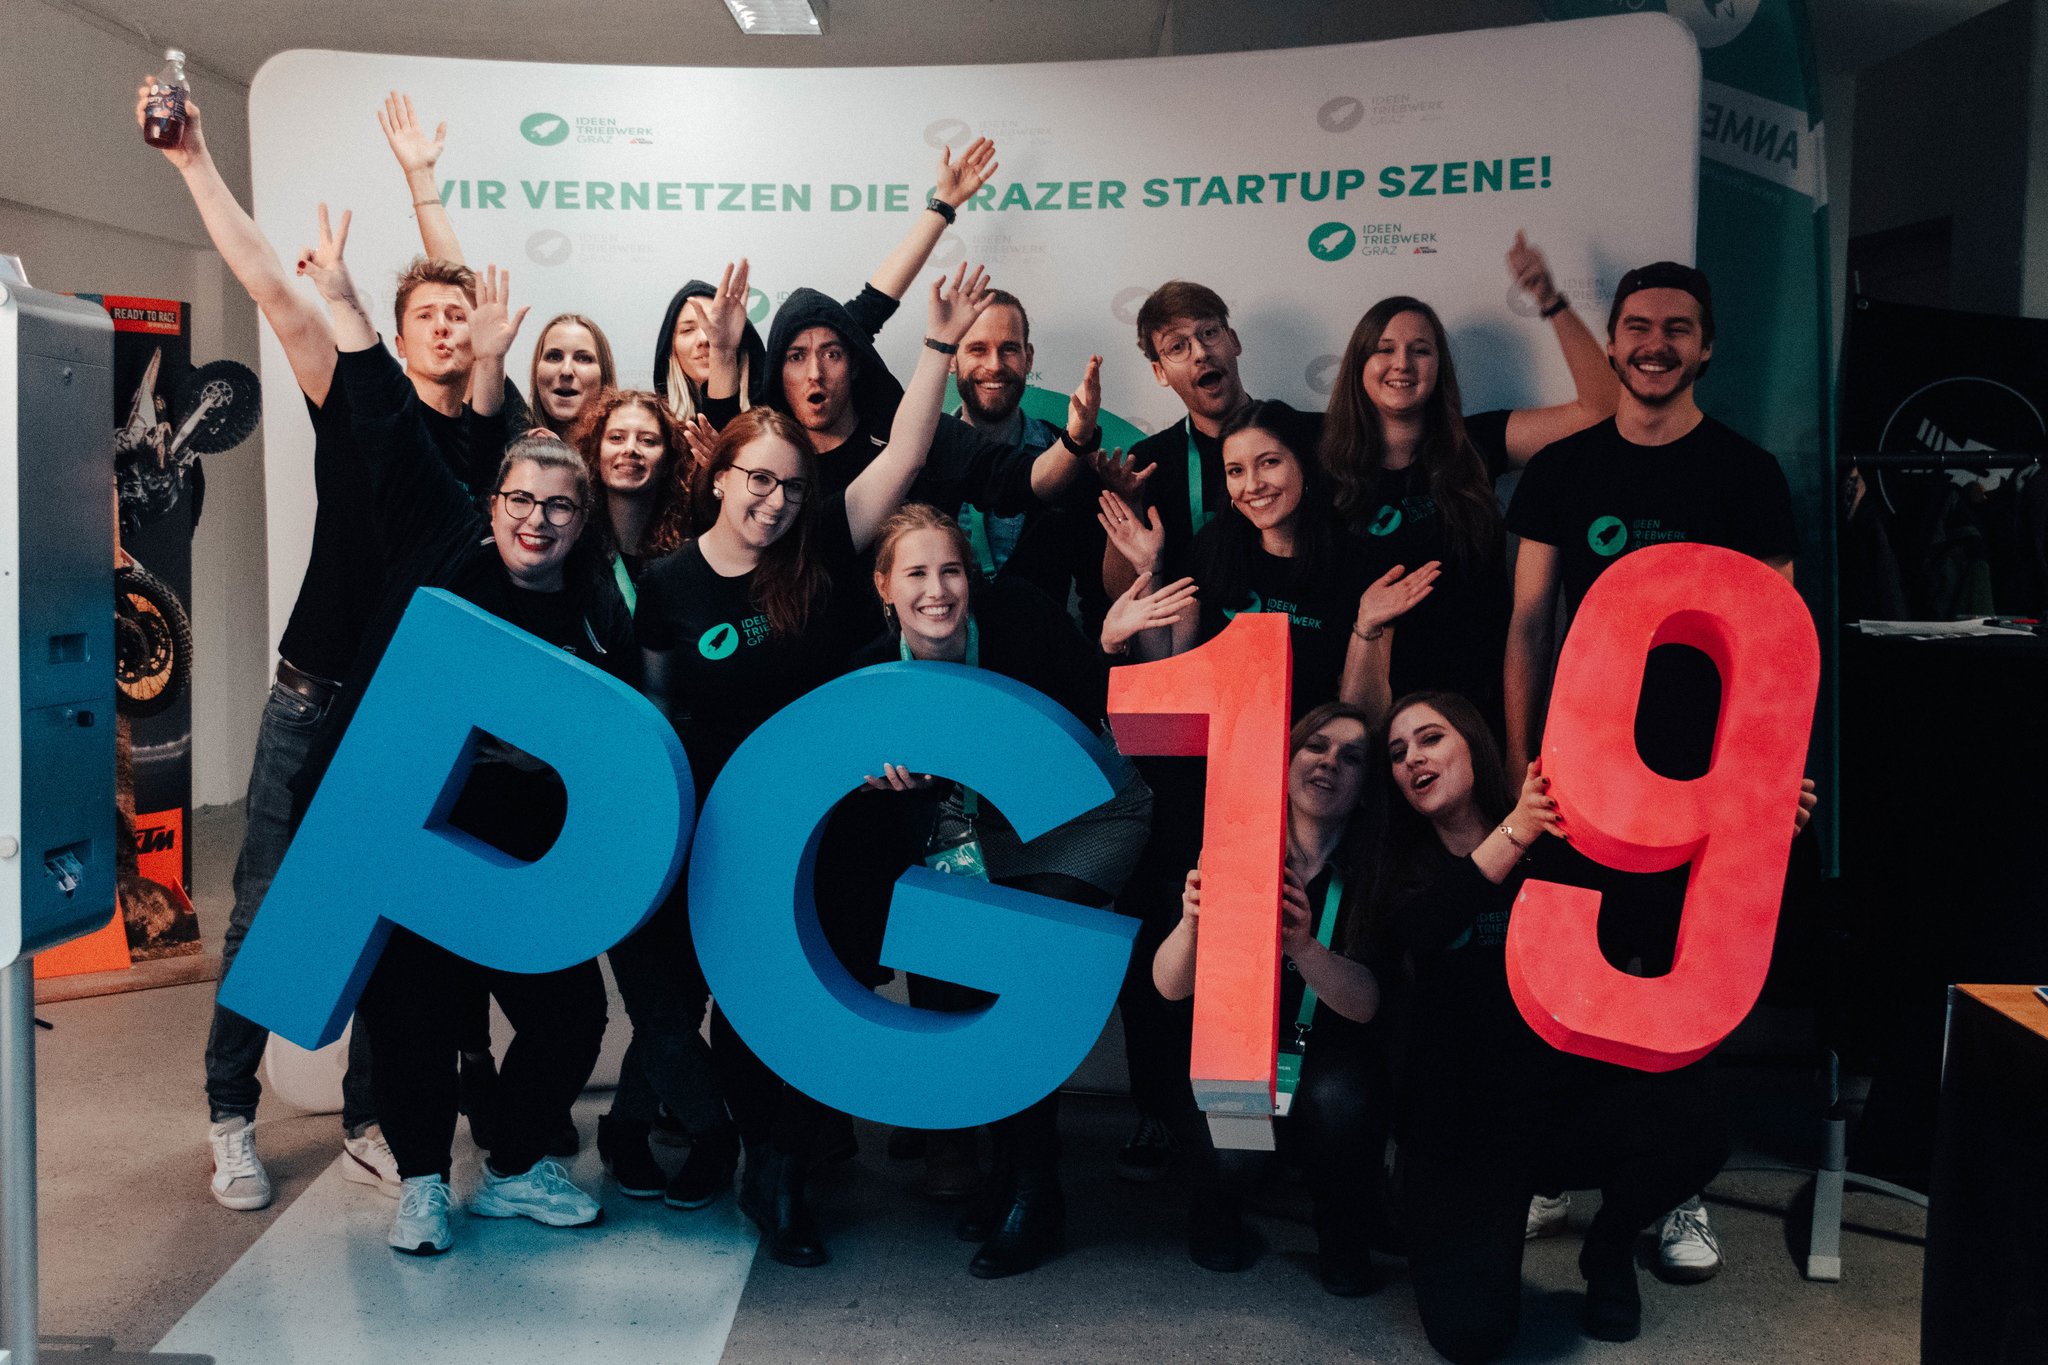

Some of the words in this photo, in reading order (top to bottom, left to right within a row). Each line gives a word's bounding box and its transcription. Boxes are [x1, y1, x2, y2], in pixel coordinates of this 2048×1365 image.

[576, 117, 617, 126] IDEEN
[576, 126, 654, 136] TRIEBWERK
[576, 135, 613, 145] GRAZ
[520, 180, 812, 213] VERNETZEN
[830, 183, 910, 213] DIE
[1142, 169, 1366, 208] STARTUP
[1378, 155, 1553, 199] SZENE!
[1362, 223, 1402, 234] IDEEN
[1362, 233, 1438, 245] TRIEBWERK
[1361, 246, 1398, 256] GRAZ
[114, 308, 145, 320] READY
[147, 311, 157, 321] TO
[158, 312, 175, 323] RACE
[1267, 598, 1298, 614] IDEEN
